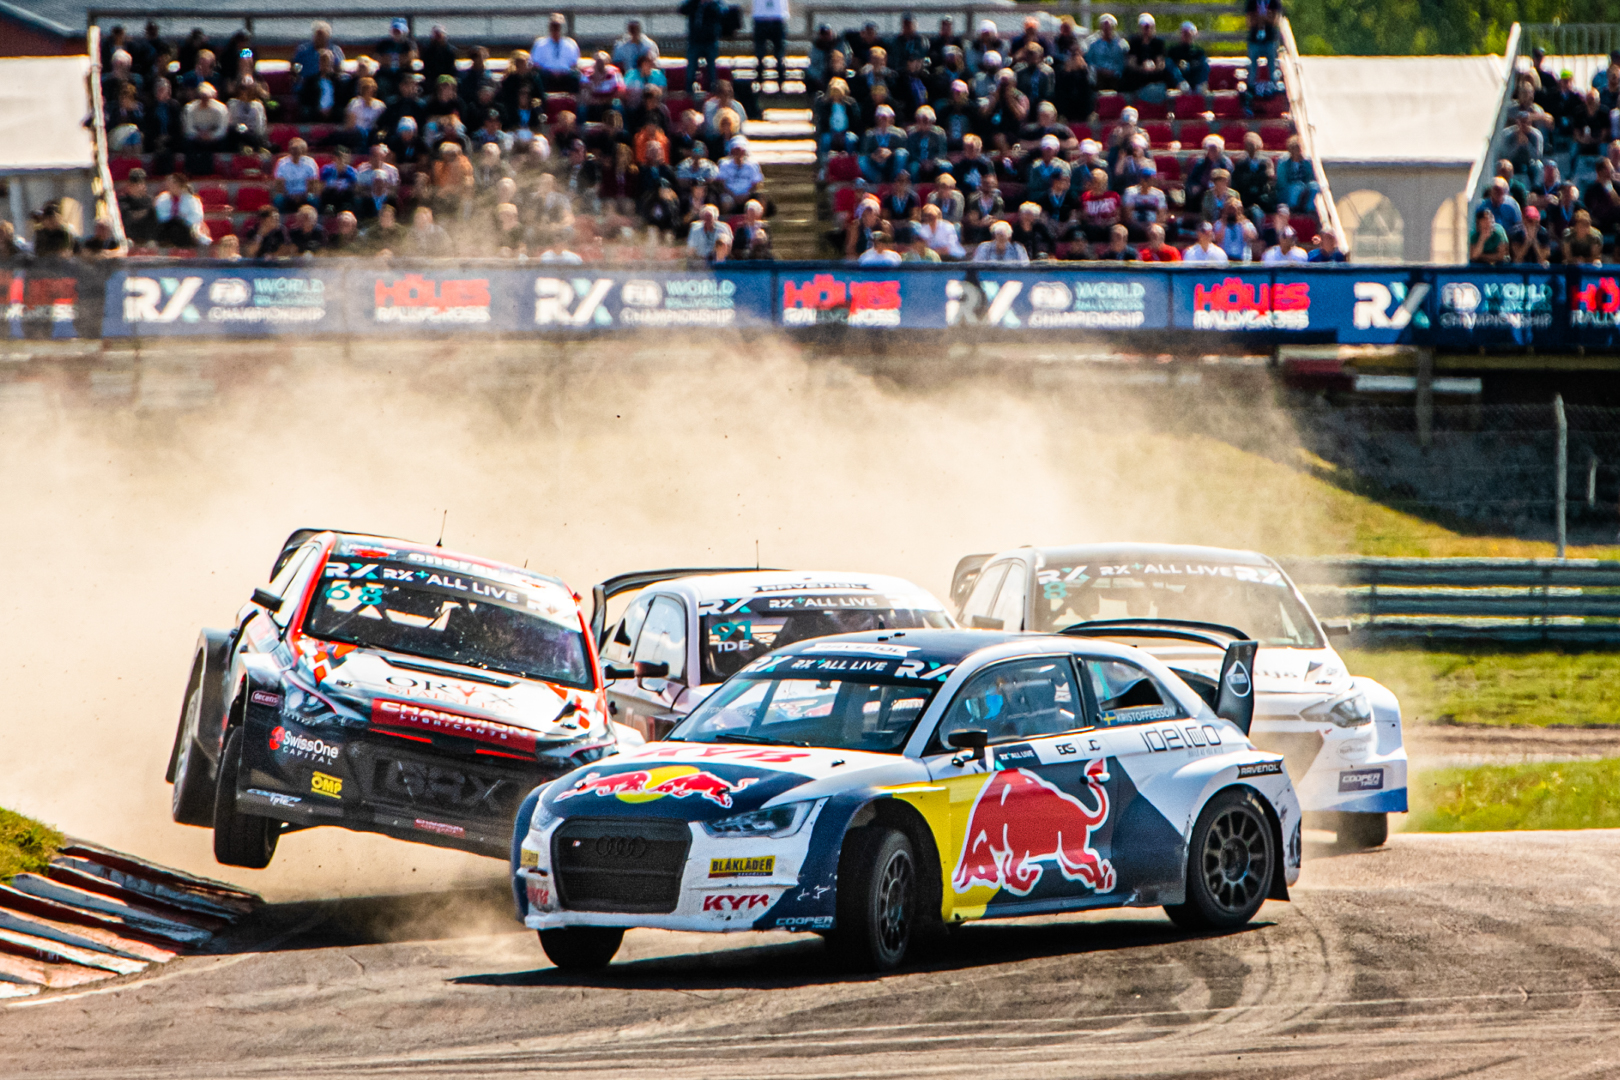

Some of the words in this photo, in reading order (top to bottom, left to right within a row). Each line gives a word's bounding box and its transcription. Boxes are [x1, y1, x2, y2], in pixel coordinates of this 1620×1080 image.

[666, 279, 736, 296] WORLD
[1075, 282, 1145, 298] WORLD
[123, 276, 204, 322] RX
[535, 277, 614, 325] RX
[946, 279, 1023, 328] RX
[1353, 281, 1432, 329] RX
[325, 562, 379, 580] RX
[472, 582, 518, 604] LIVE
[1038, 566, 1090, 584] RX
[1186, 565, 1233, 577] LIVE
[325, 583, 383, 605] 68
[699, 598, 753, 616] RX
[840, 597, 877, 607] LIVE
[711, 620, 752, 642] 91
[850, 661, 888, 671] LIVE
[894, 659, 957, 682] RX
[380, 702, 529, 737] CHAMPION
[1116, 707, 1176, 722] KRISTOFFERSSON
[400, 714, 508, 740] LUBRICANTS
[283, 731, 339, 759] SwissOne
[283, 747, 333, 766] CAPITAL
[1240, 763, 1280, 775] RAVENOL
[1341, 773, 1381, 783] COOPER
[311, 774, 342, 796] OMP
[712, 858, 773, 872] BLÅKLÄDER
[776, 916, 834, 926] COOPER
